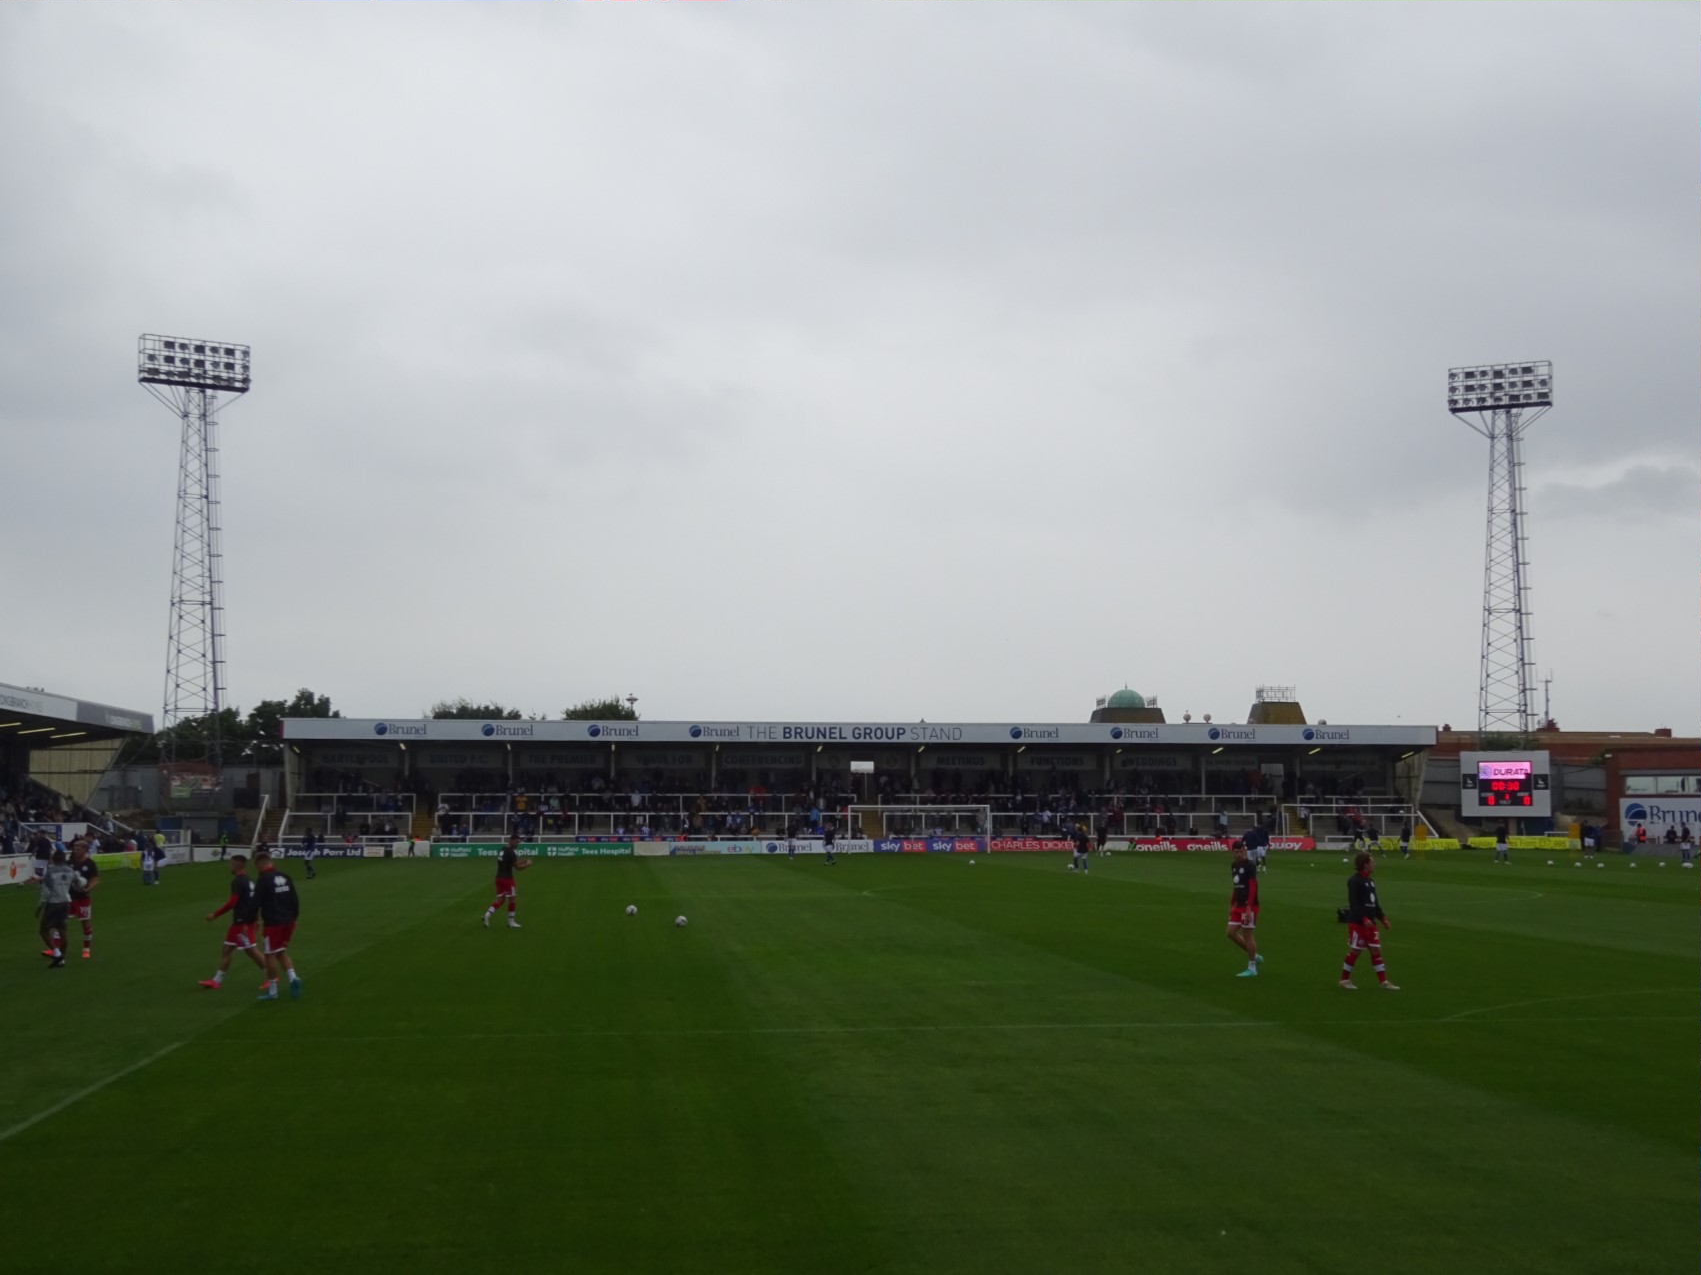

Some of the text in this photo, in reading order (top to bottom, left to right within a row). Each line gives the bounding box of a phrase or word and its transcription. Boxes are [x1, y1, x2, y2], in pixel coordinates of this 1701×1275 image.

[387, 723, 427, 736] Brunel
[495, 725, 533, 737] Brunel
[601, 725, 639, 737] Brunel
[703, 726, 739, 738] Brunel
[748, 726, 963, 740] THE BRUNEL GROUP STAND
[1022, 727, 1060, 739] Brunel
[1123, 727, 1159, 740] Brunel
[1219, 728, 1256, 740] Brunel
[1314, 728, 1350, 741] Brunel
[600, 847, 631, 855] Hospital
[881, 840, 924, 852] sky bet
[932, 841, 976, 852] sky bet
[991, 840, 1040, 850] CHARLES
[323, 848, 361, 856] Parr Ltd
